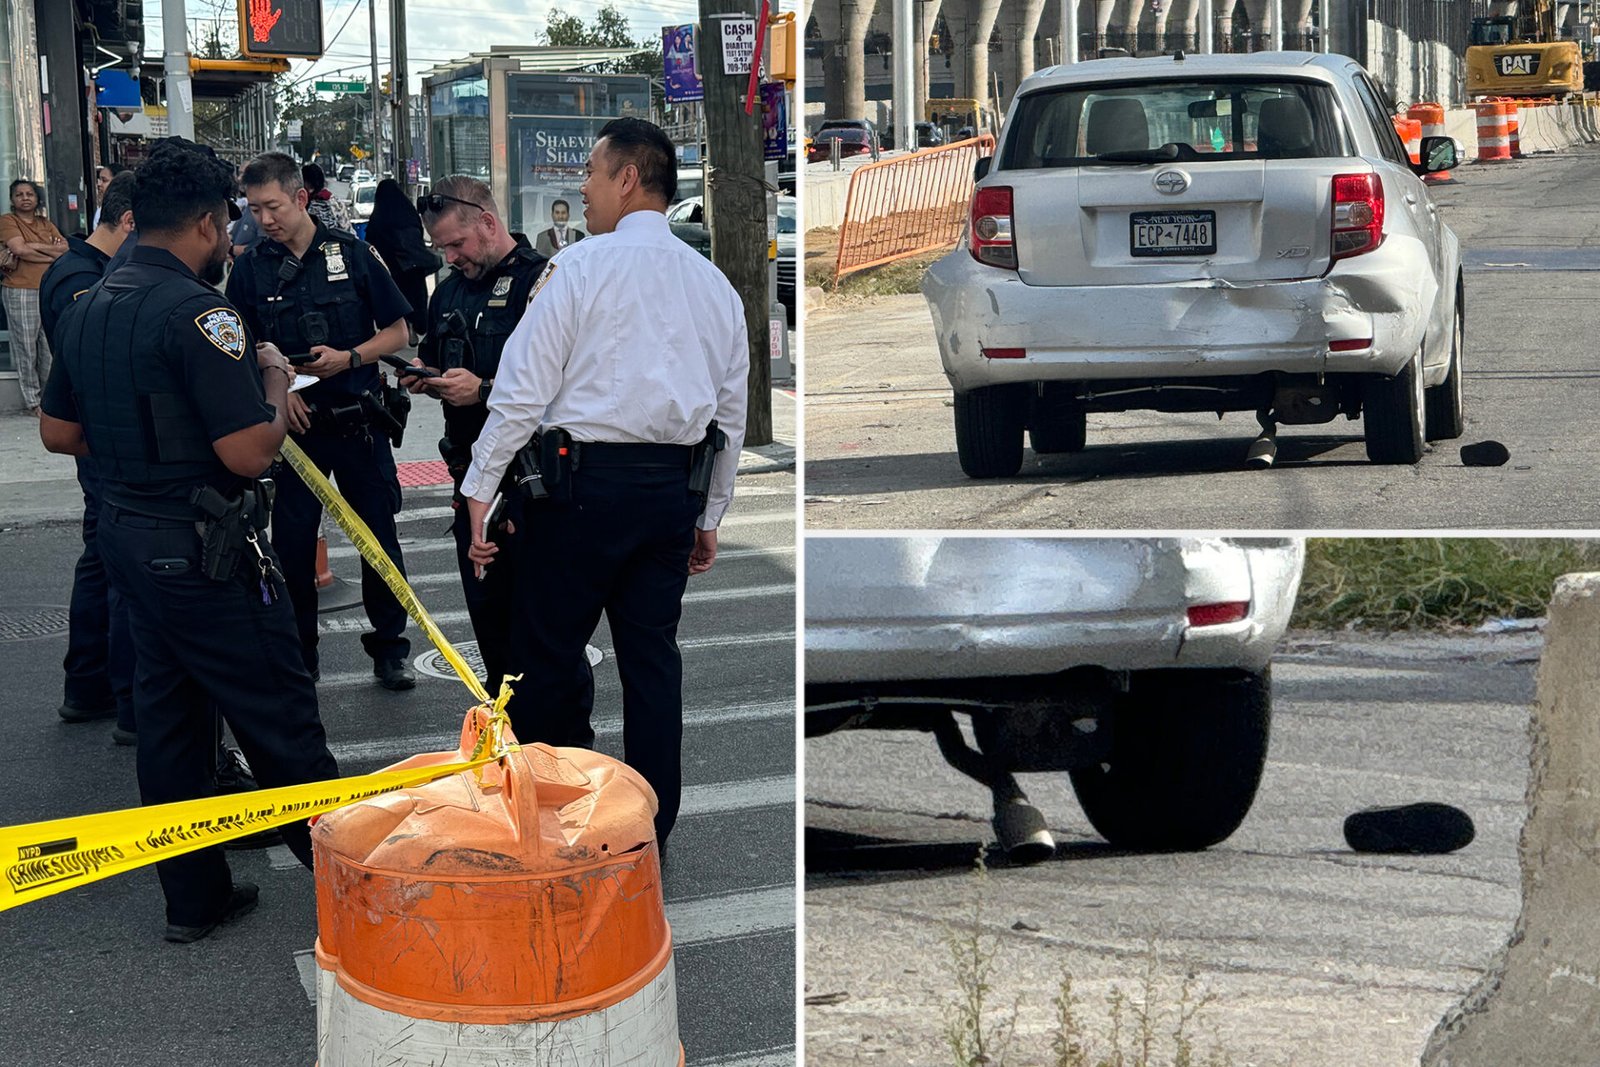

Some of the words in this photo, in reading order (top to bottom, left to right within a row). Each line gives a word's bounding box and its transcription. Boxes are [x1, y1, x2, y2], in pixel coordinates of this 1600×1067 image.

[724, 24, 753, 35] CASH
[1502, 55, 1532, 74] CAT
[546, 147, 590, 163] SHAE
[1151, 216, 1170, 224] NEW
[1173, 214, 1195, 223] YORK
[1138, 225, 1164, 247] ECP
[1174, 224, 1207, 246] 7448
[19, 846, 42, 860] NYPD
